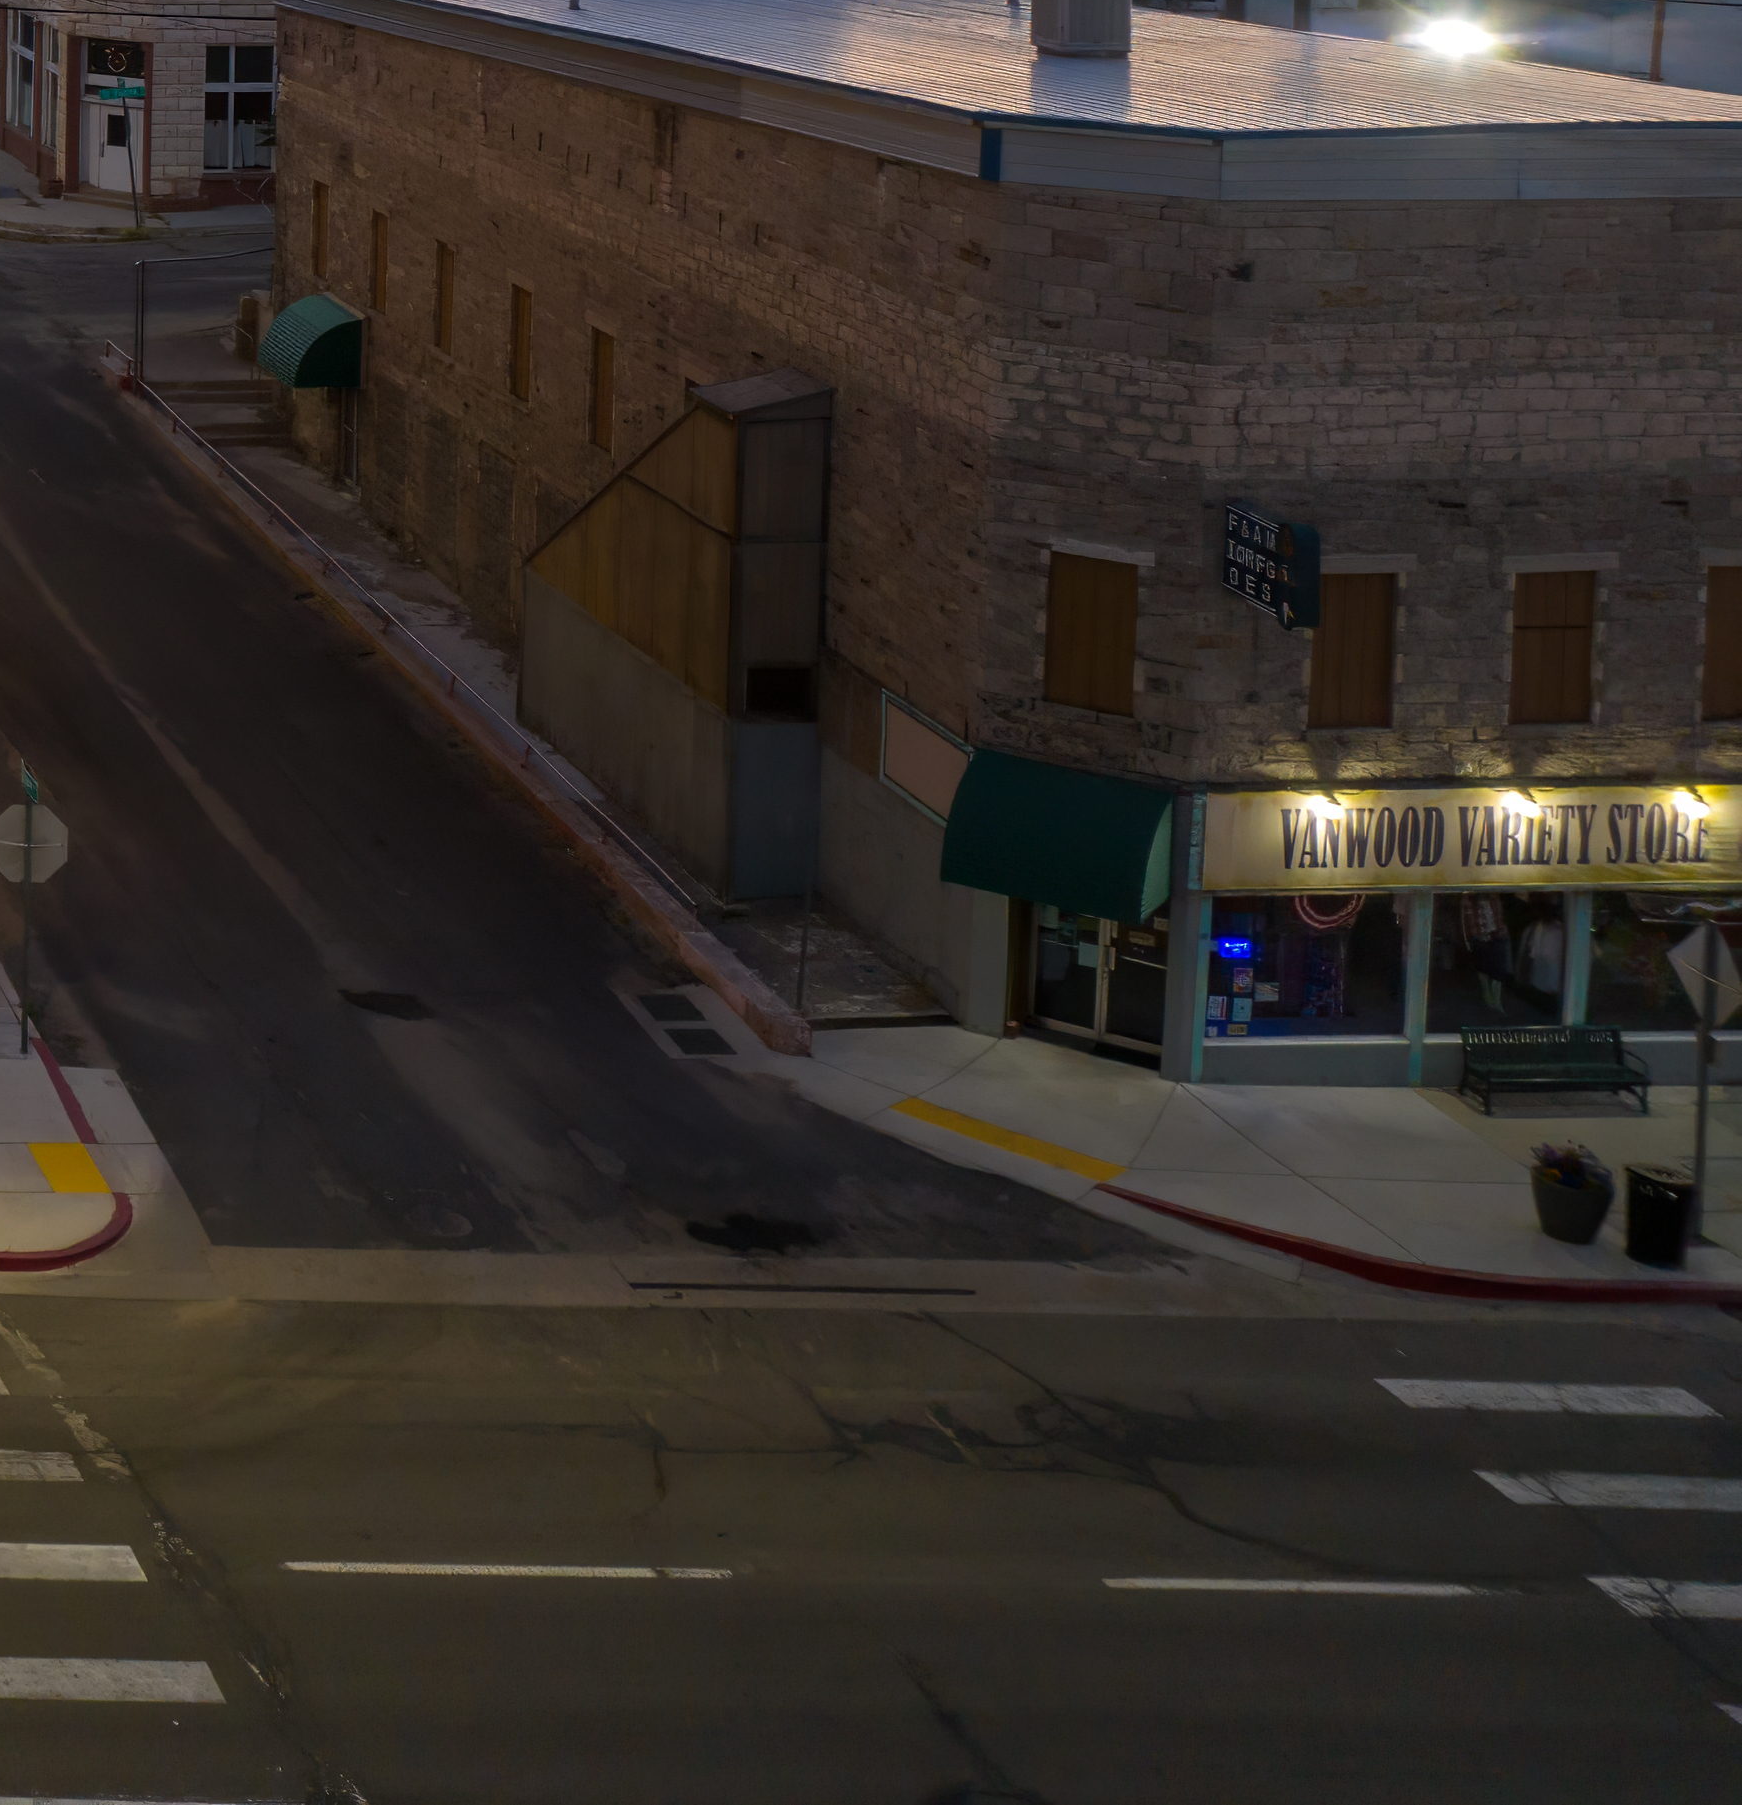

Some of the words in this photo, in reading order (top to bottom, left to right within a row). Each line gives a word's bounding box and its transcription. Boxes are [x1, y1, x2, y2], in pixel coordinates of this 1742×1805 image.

[1281, 806, 1445, 869] VANWOOD
[1458, 804, 1597, 867] VARIETY
[1606, 802, 1710, 864] STORE
